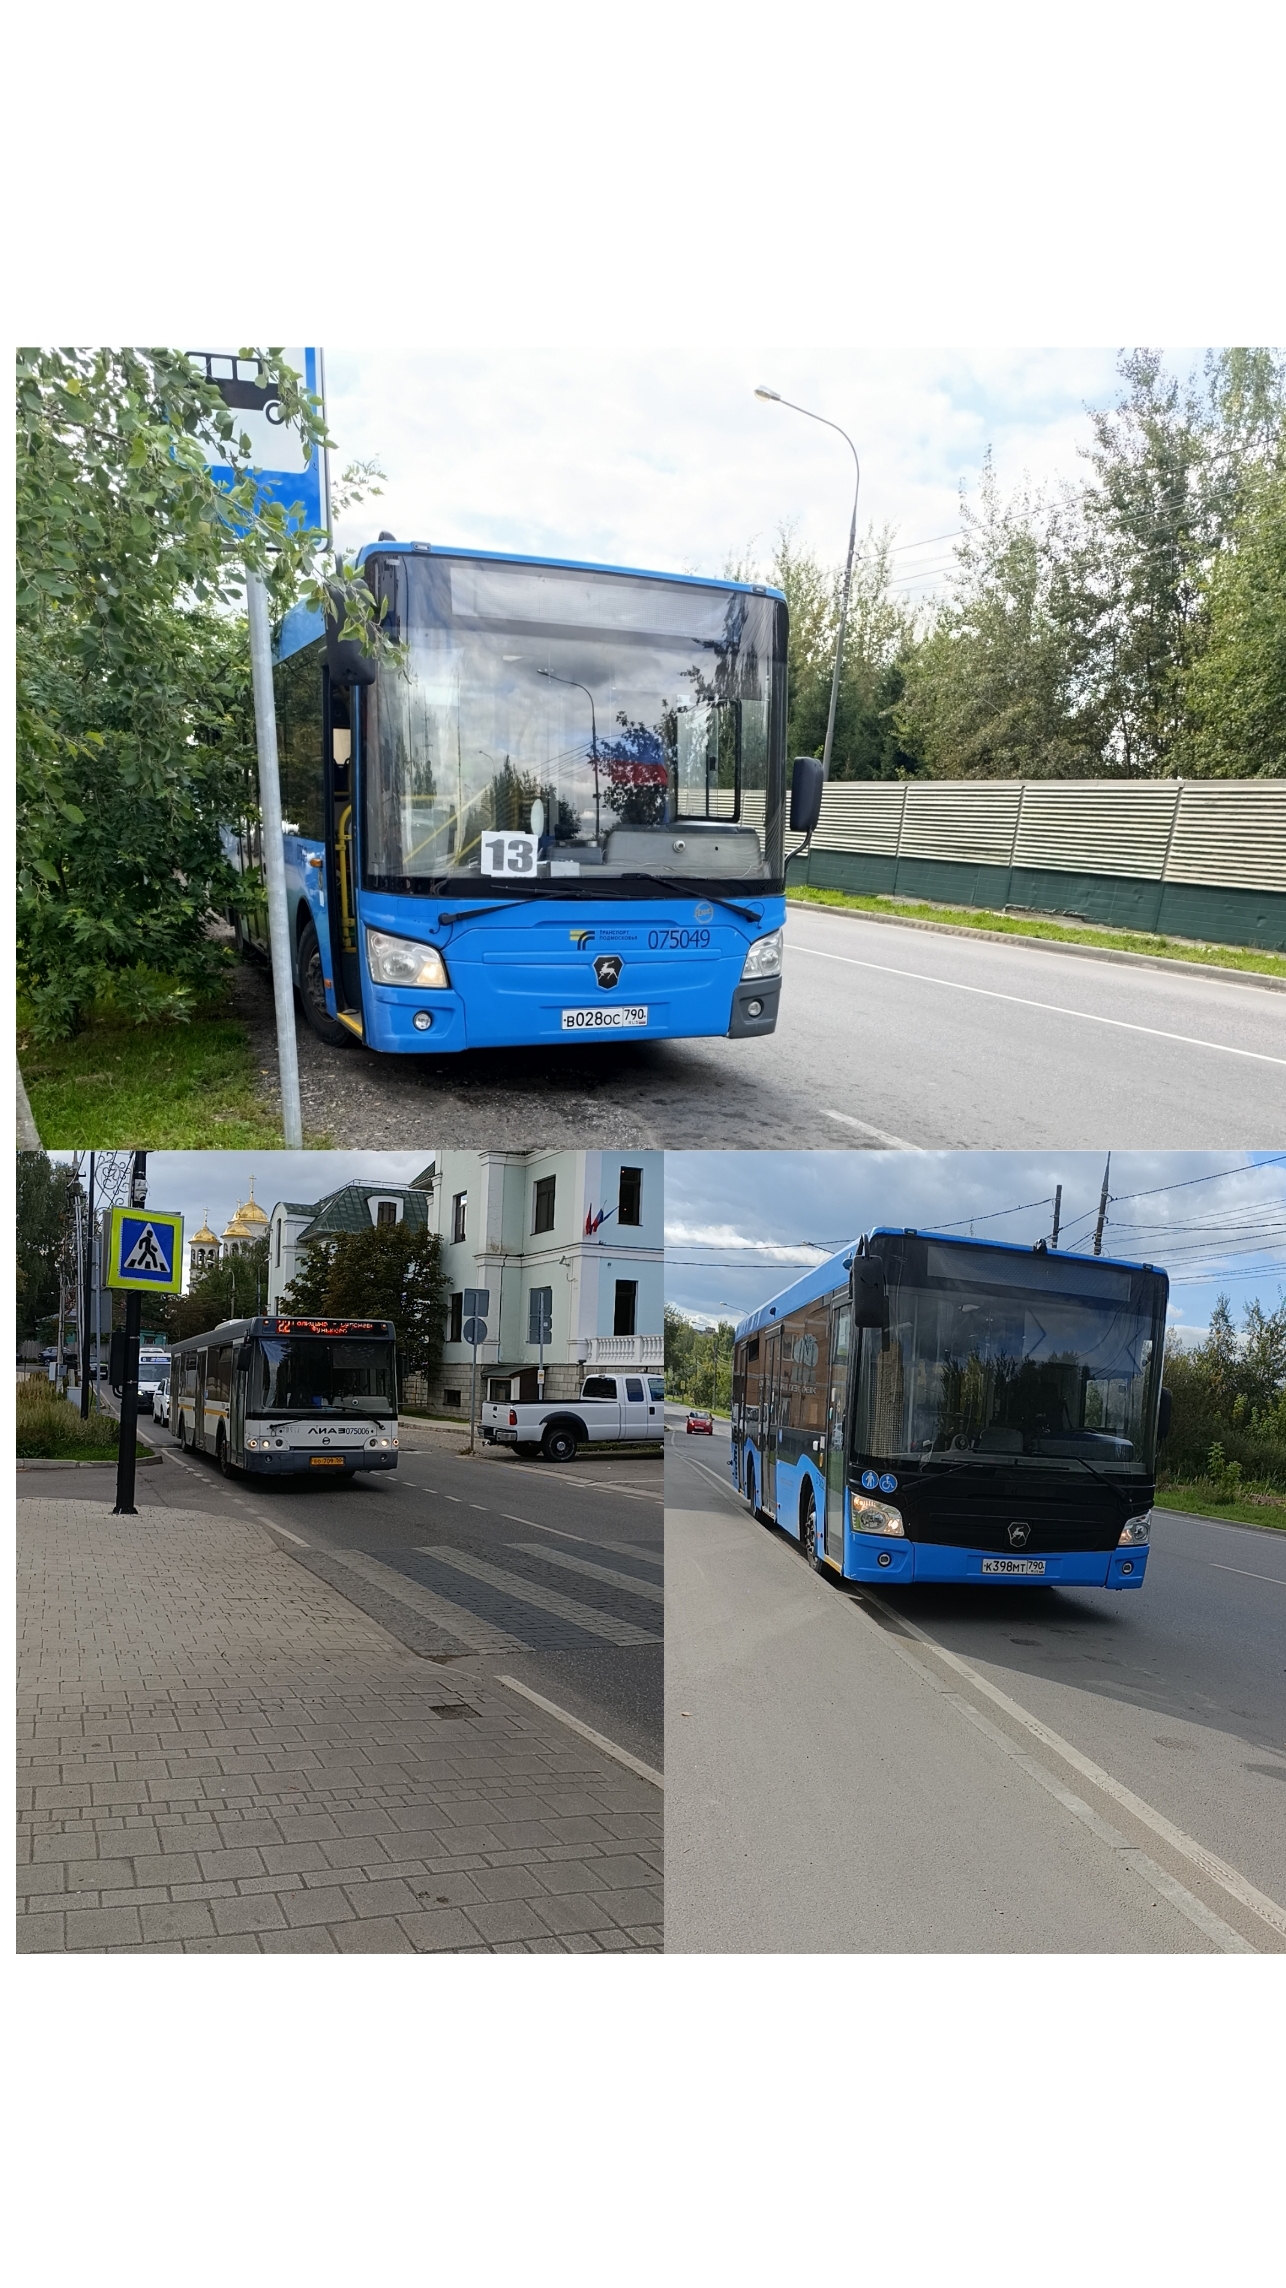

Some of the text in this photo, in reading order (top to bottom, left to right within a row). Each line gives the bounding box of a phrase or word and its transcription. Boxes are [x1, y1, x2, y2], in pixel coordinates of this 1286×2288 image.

[485, 838, 533, 872] 13
[647, 929, 710, 949] 075049
[624, 1008, 644, 1020] 790
[278, 1320, 291, 1333] 22
[1028, 1560, 1044, 1570] 790
